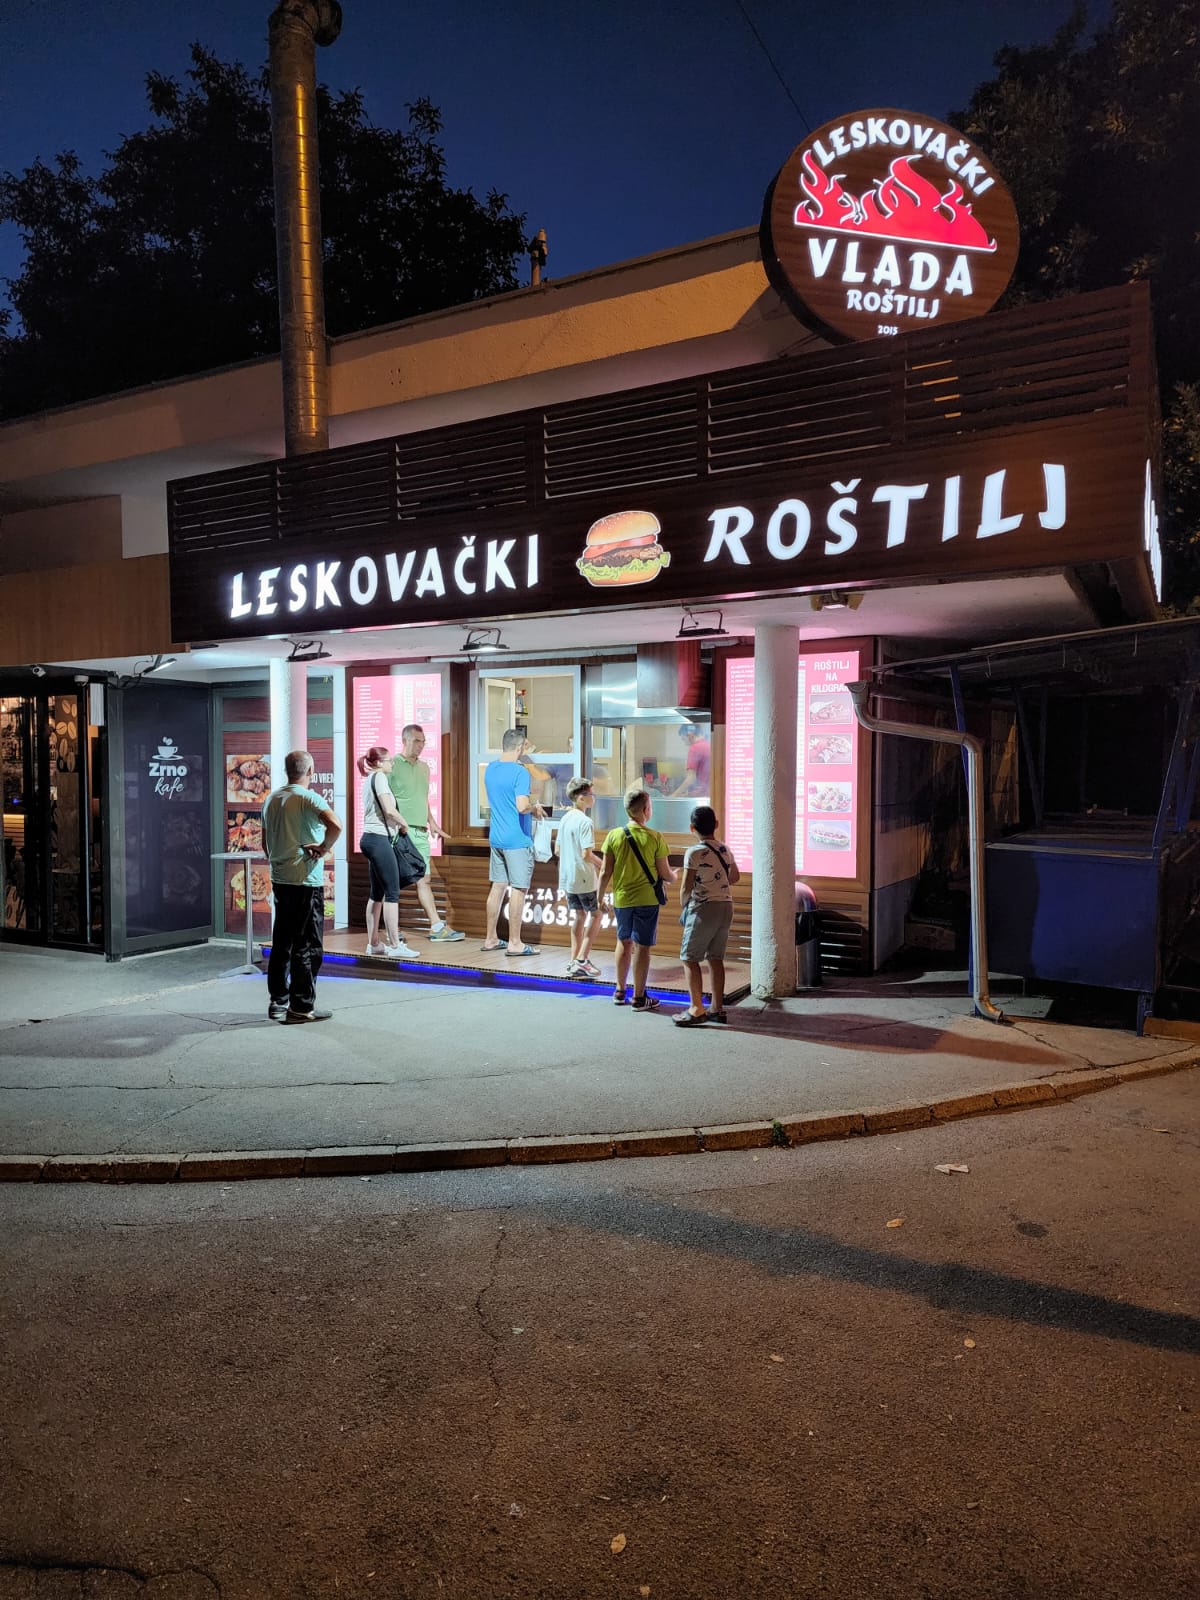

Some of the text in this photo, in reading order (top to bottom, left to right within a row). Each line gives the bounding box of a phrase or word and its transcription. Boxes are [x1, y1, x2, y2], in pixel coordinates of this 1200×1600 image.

[812, 117, 995, 196] LESKOVAČKI
[808, 238, 973, 296] VLADA
[847, 289, 940, 318] ROŠTILJ
[877, 325, 898, 336] 2015
[230, 533, 538, 619] LESKOVAČKI
[703, 463, 1066, 565] ROŠTILJ
[814, 659, 850, 671] ROŠTILJ
[825, 672, 838, 682] NA
[811, 683, 850, 693] KILOGRA
[149, 762, 188, 777] Zrno
[154, 776, 184, 800] kafe
